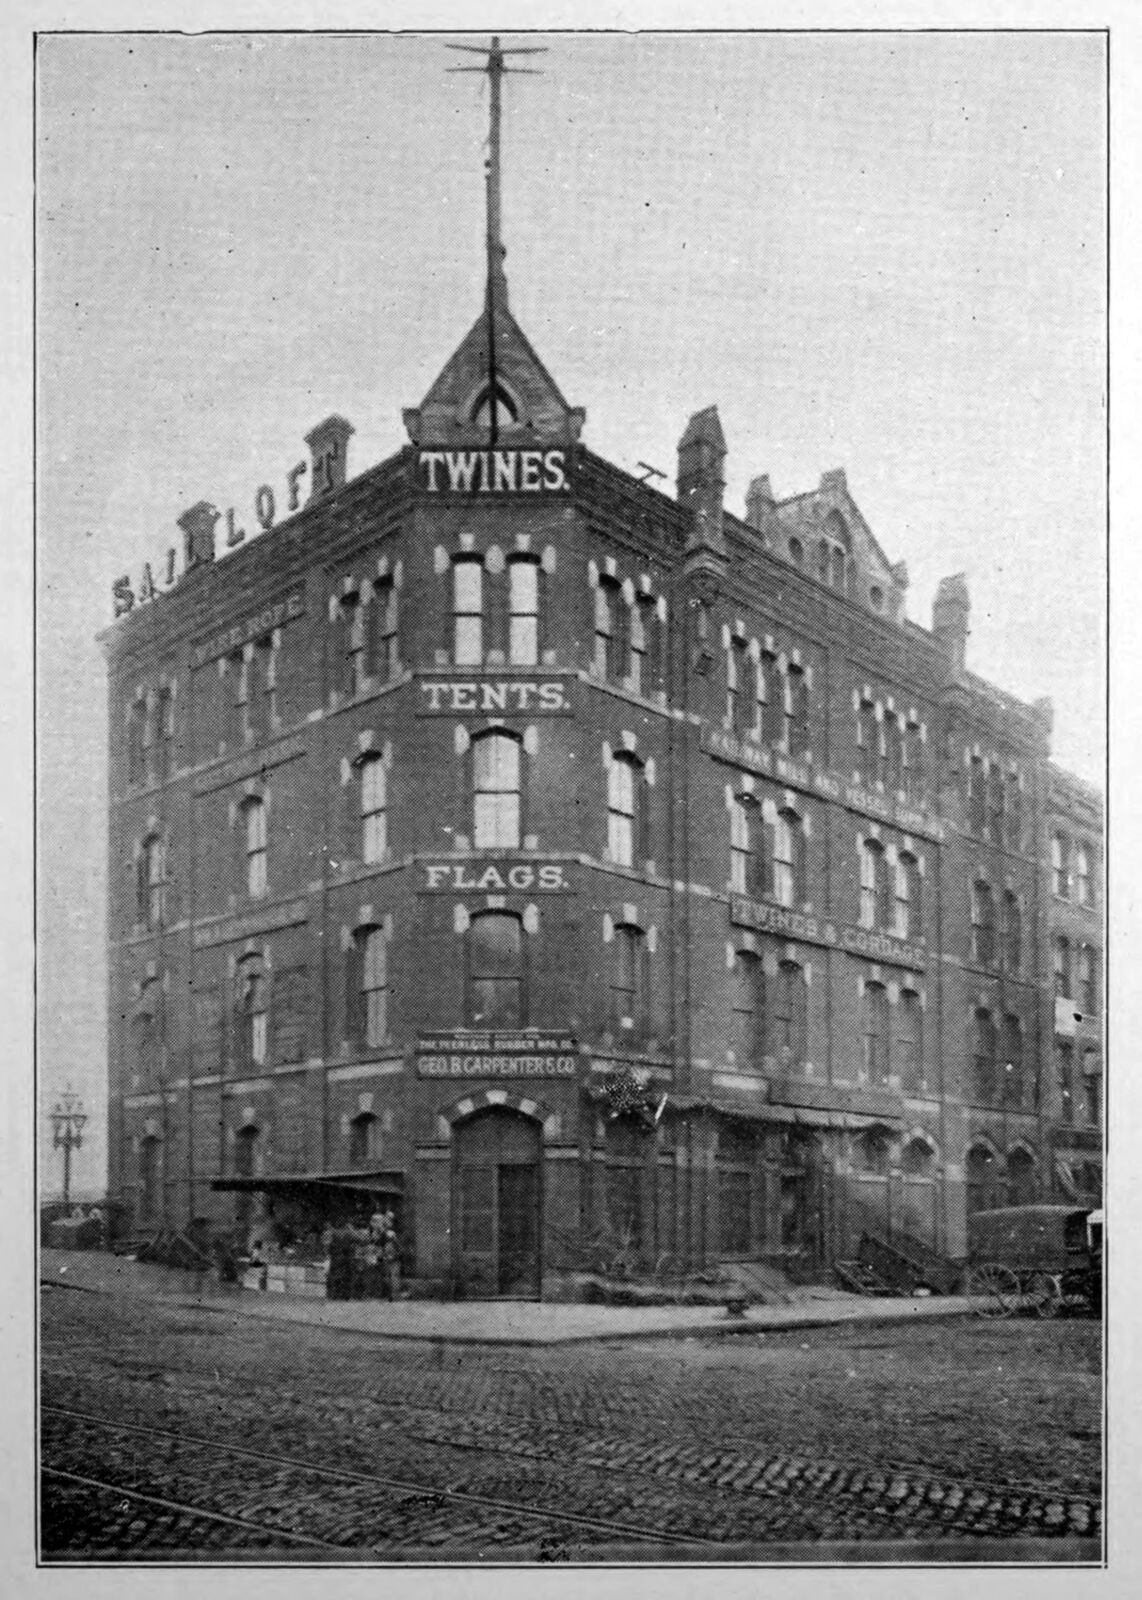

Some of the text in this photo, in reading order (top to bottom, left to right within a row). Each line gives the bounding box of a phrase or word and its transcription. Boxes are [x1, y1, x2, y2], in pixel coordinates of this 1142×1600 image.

[419, 450, 571, 492] TWINES.
[225, 441, 338, 548] LOFT
[421, 682, 571, 710] TENTS.
[426, 866, 569, 889] FLAGS.
[463, 1056, 545, 1075] CARPENTER
